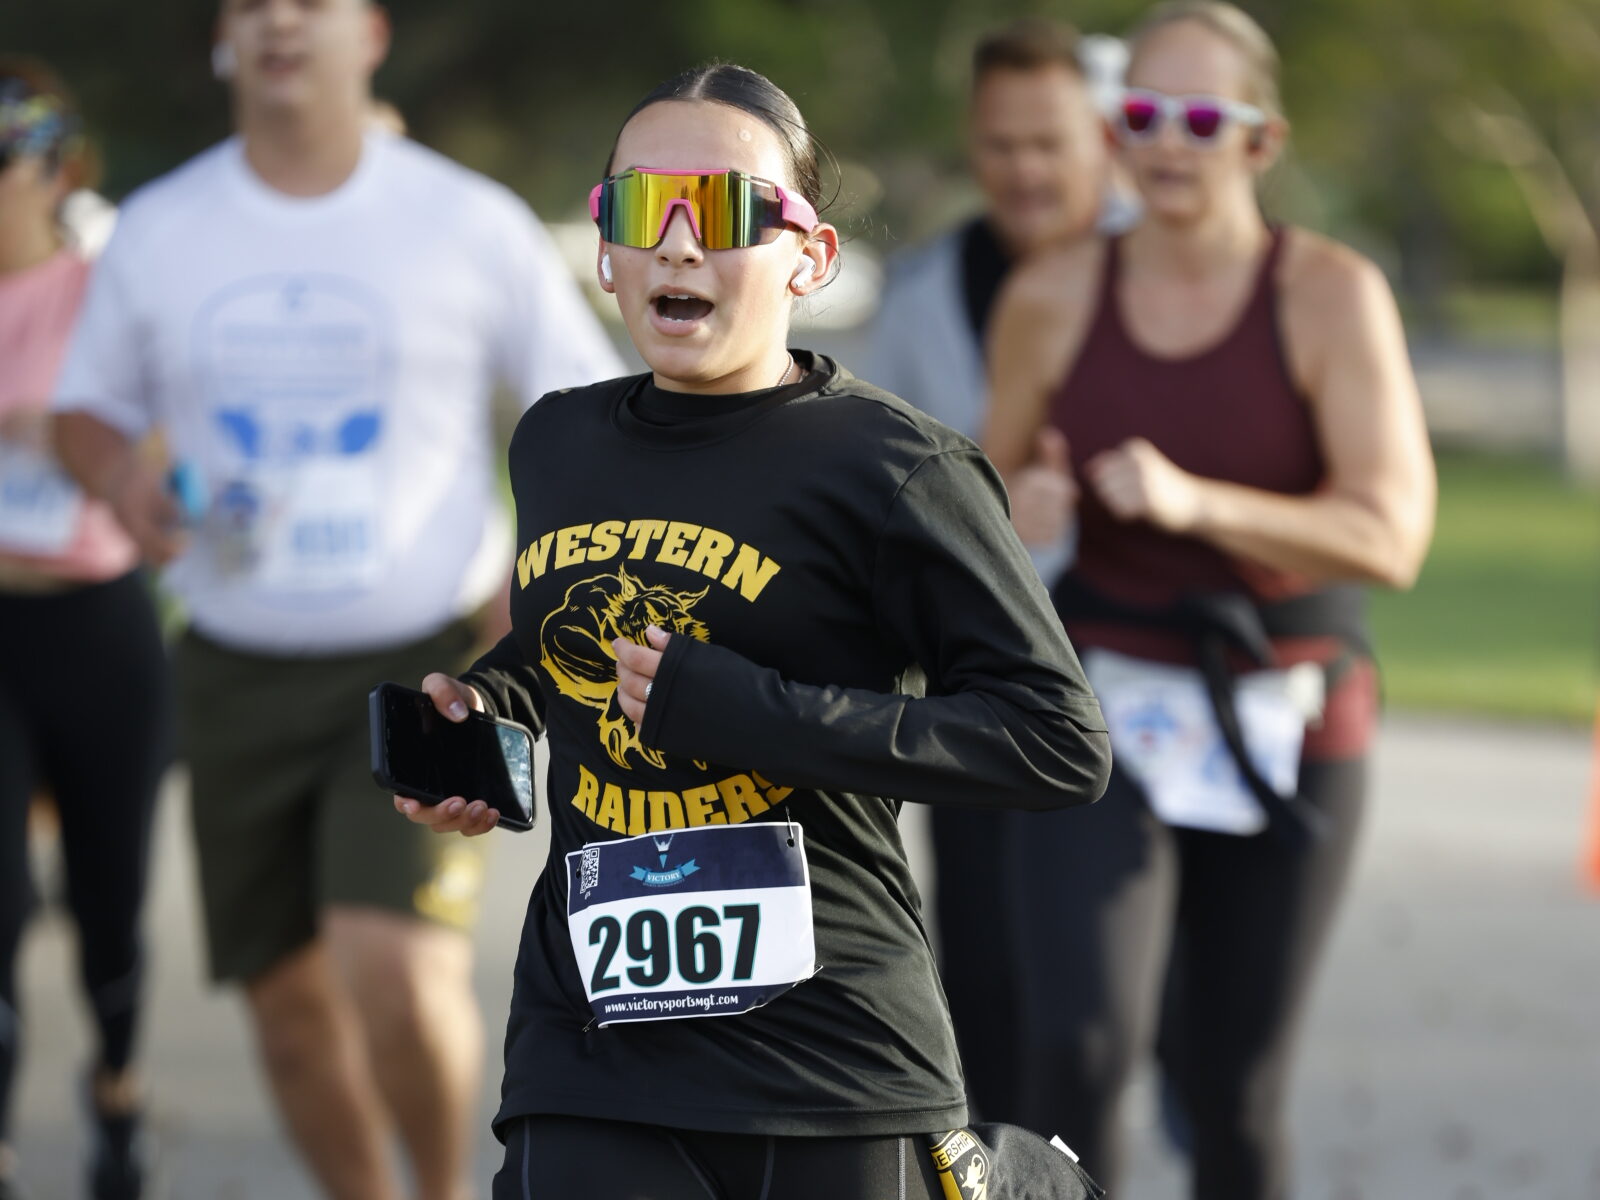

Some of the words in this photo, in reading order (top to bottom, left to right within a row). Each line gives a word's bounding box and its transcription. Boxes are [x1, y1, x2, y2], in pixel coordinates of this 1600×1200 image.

[517, 519, 782, 603] WESTERN
[647, 871, 681, 882] VICTORY
[588, 903, 761, 995] 2967
